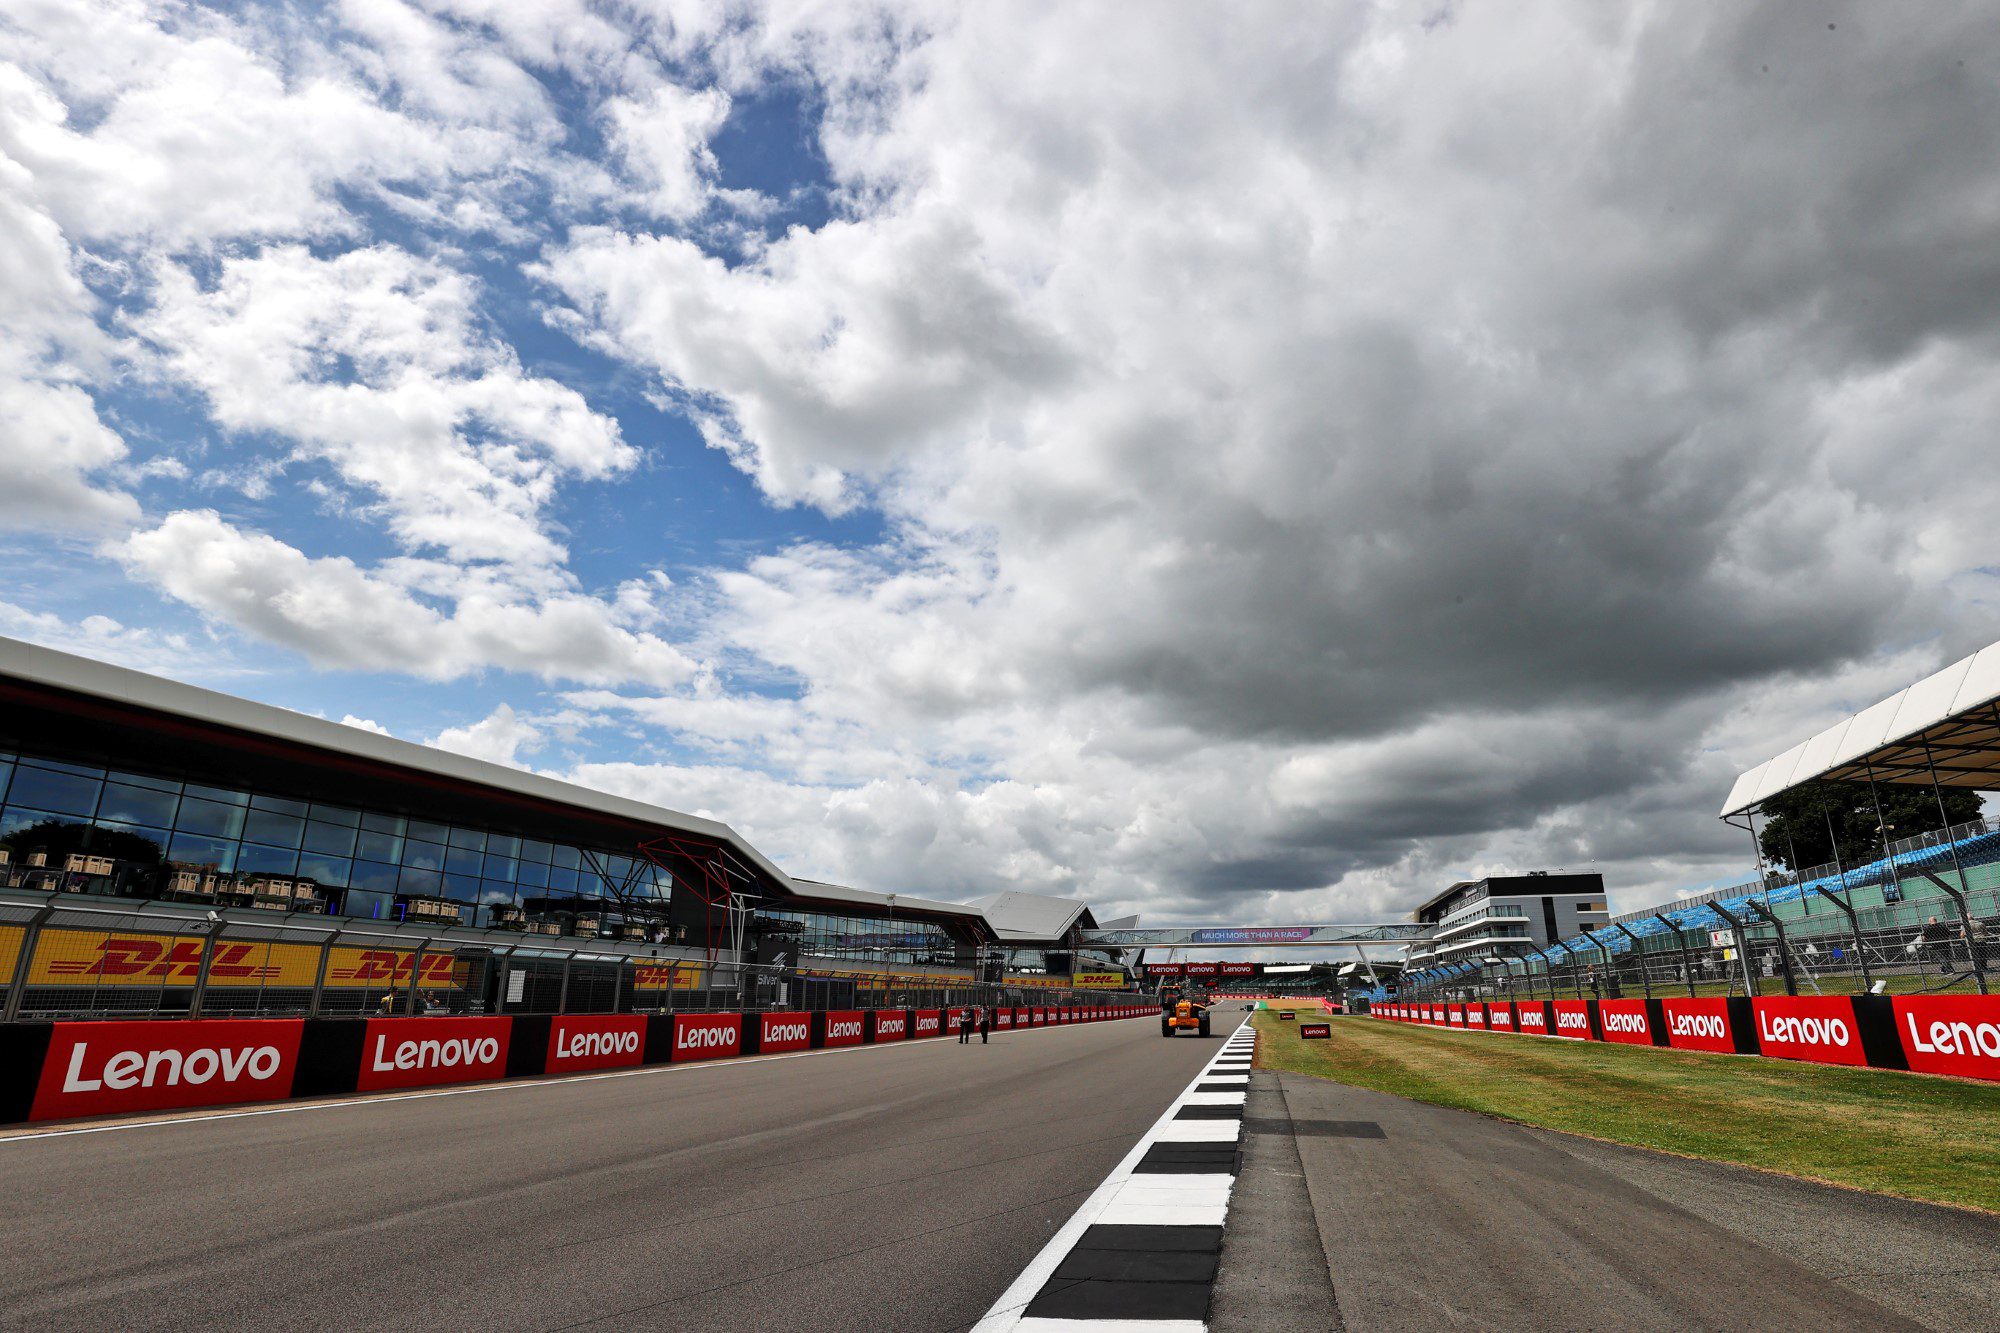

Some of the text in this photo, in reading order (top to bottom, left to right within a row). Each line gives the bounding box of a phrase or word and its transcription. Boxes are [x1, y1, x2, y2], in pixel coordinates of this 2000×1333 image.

[86, 938, 255, 977] DHL
[353, 951, 456, 980] DHL
[634, 966, 682, 984] DHL
[1152, 965, 1179, 973] Lenovo
[1187, 965, 1215, 973] Lenovo
[1222, 965, 1251, 973] Lenovo
[1083, 975, 1114, 984] DHL
[878, 1018, 903, 1033] Lenovo
[917, 1016, 938, 1030] Lenovo
[998, 1014, 1010, 1024] Lenovo
[1519, 1009, 1543, 1026] Lenovo
[1555, 1009, 1587, 1029] Lenovo
[1603, 1010, 1645, 1033] Lenovo
[1668, 1010, 1724, 1038] Lenovo
[678, 1024, 735, 1048] Lenovo
[765, 1022, 806, 1042] Lenovo
[828, 1019, 861, 1037] Lenovo
[1305, 1028, 1327, 1036] Lenovo
[1761, 1010, 1848, 1046] Lenovo
[1907, 1013, 2000, 1057] Leno
[373, 1035, 498, 1071] Lenovo
[557, 1029, 638, 1057] Lenovo
[63, 1043, 280, 1092] Lenovo
